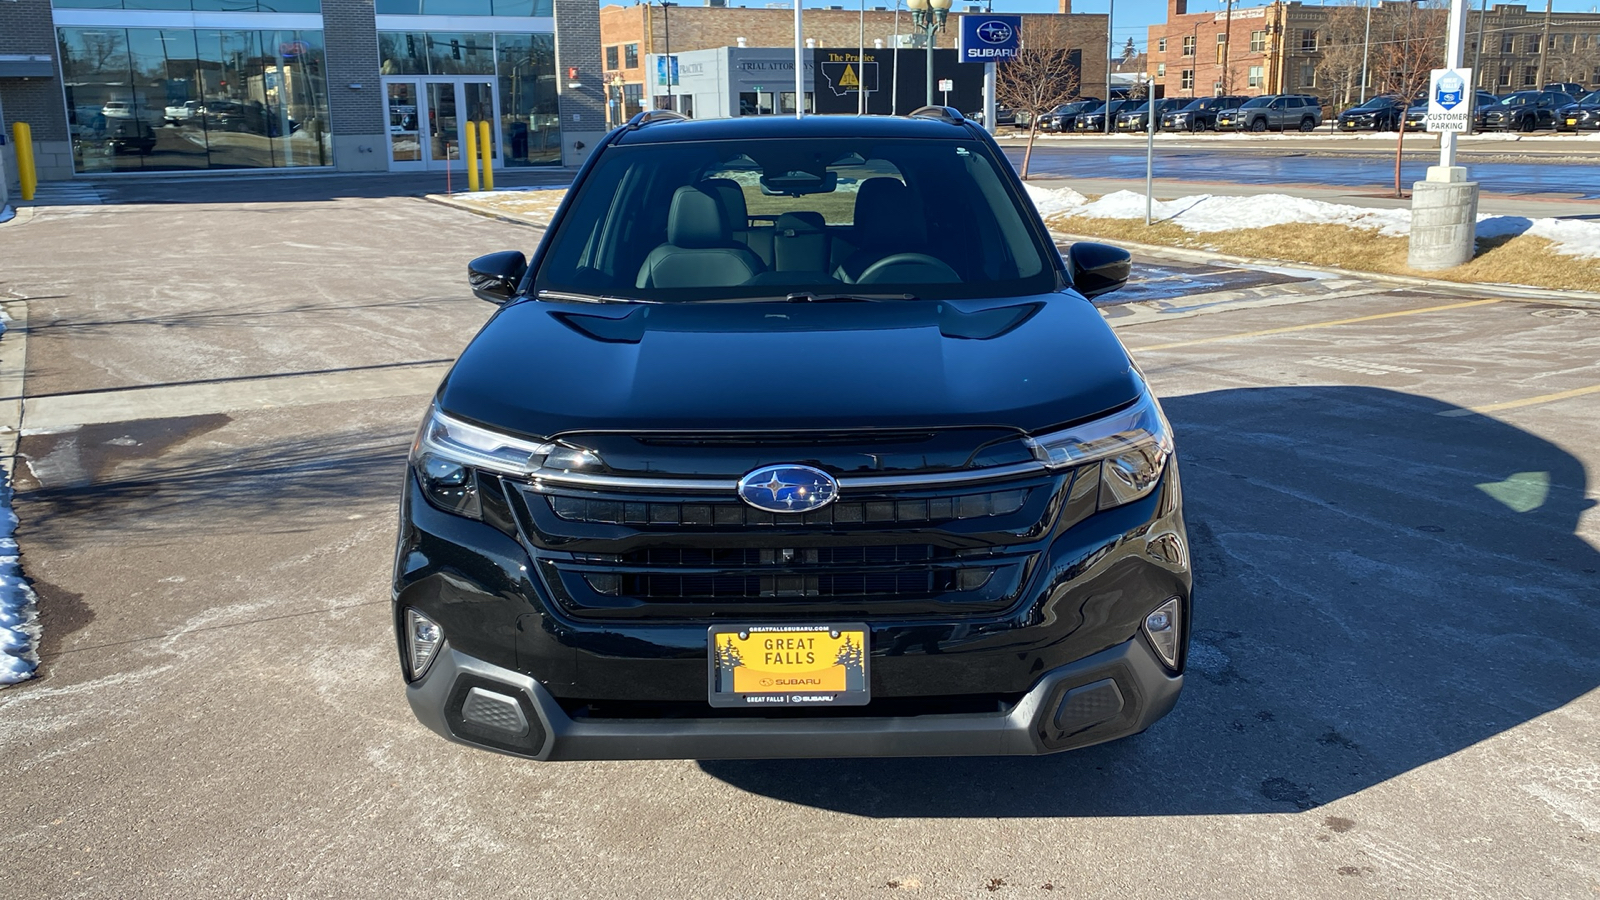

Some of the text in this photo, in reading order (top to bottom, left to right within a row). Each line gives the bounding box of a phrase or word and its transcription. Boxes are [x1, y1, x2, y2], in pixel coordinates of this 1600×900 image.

[967, 48, 1018, 57] SUBARU
[828, 53, 875, 62] The Praice
[742, 62, 814, 70] TRIAL ATTORYS
[1428, 113, 1468, 121] CUSTOMER
[1431, 122, 1463, 130] PARKING
[764, 638, 815, 651] GREAT
[765, 652, 815, 665] FALLS
[775, 678, 821, 686] SUBARU
